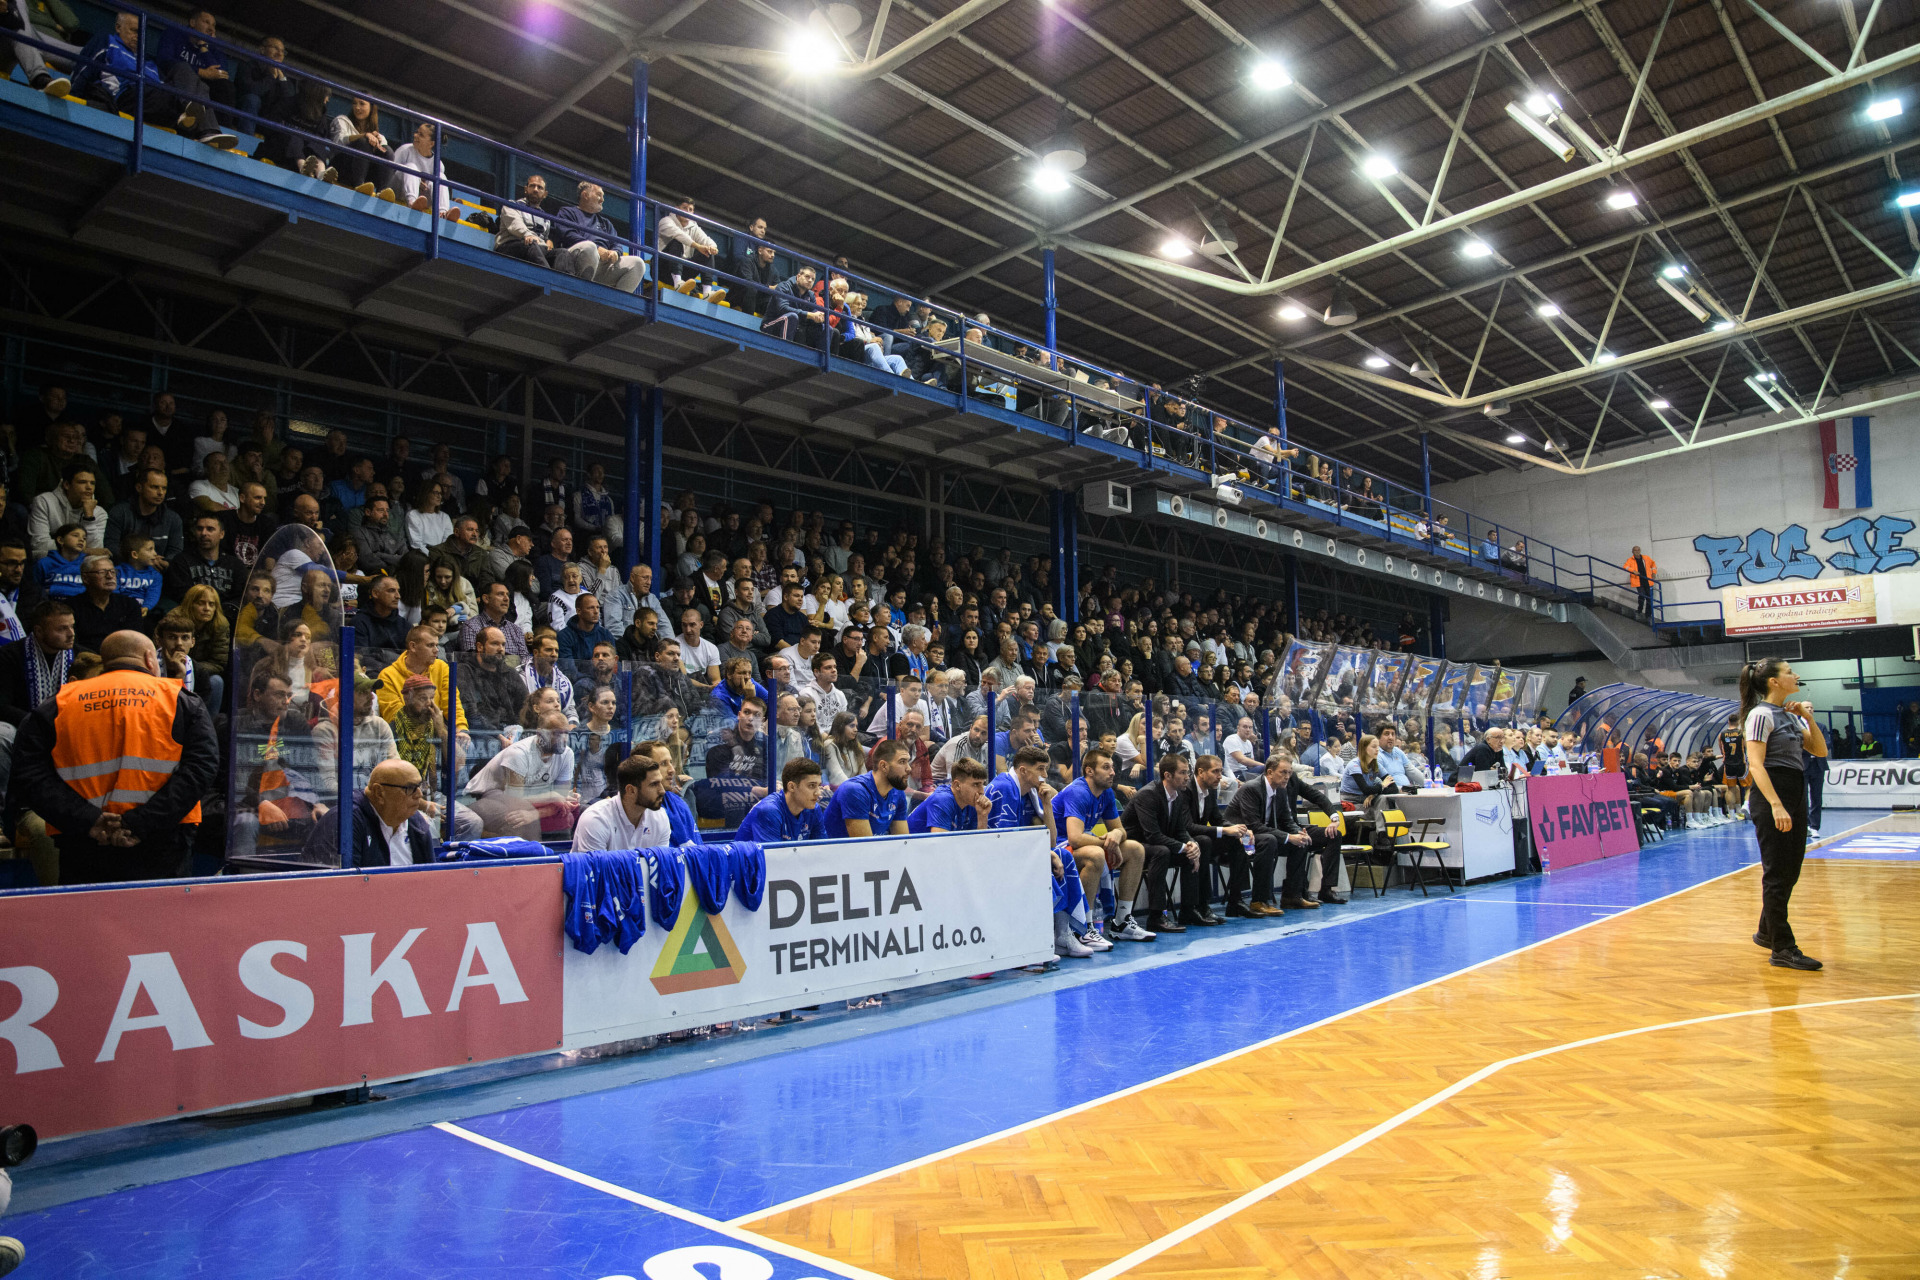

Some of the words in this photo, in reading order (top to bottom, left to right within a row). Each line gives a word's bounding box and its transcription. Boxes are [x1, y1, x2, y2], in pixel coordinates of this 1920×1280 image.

[1821, 515, 1920, 574] JE
[1753, 590, 1843, 608] MARASKA
[1777, 610, 1804, 620] godina
[1805, 606, 1838, 616] tradicije
[78, 688, 156, 701] MEDITERAN
[84, 699, 148, 712] SECURITY
[1729, 743, 1737, 755] 7
[1827, 768, 1920, 786] UPERNO
[1557, 799, 1630, 840] FAVBET
[768, 866, 922, 930] DELTA
[769, 924, 924, 975] TERMINALI
[932, 924, 986, 950] d.o.o.
[0, 922, 530, 1075] RASKA
